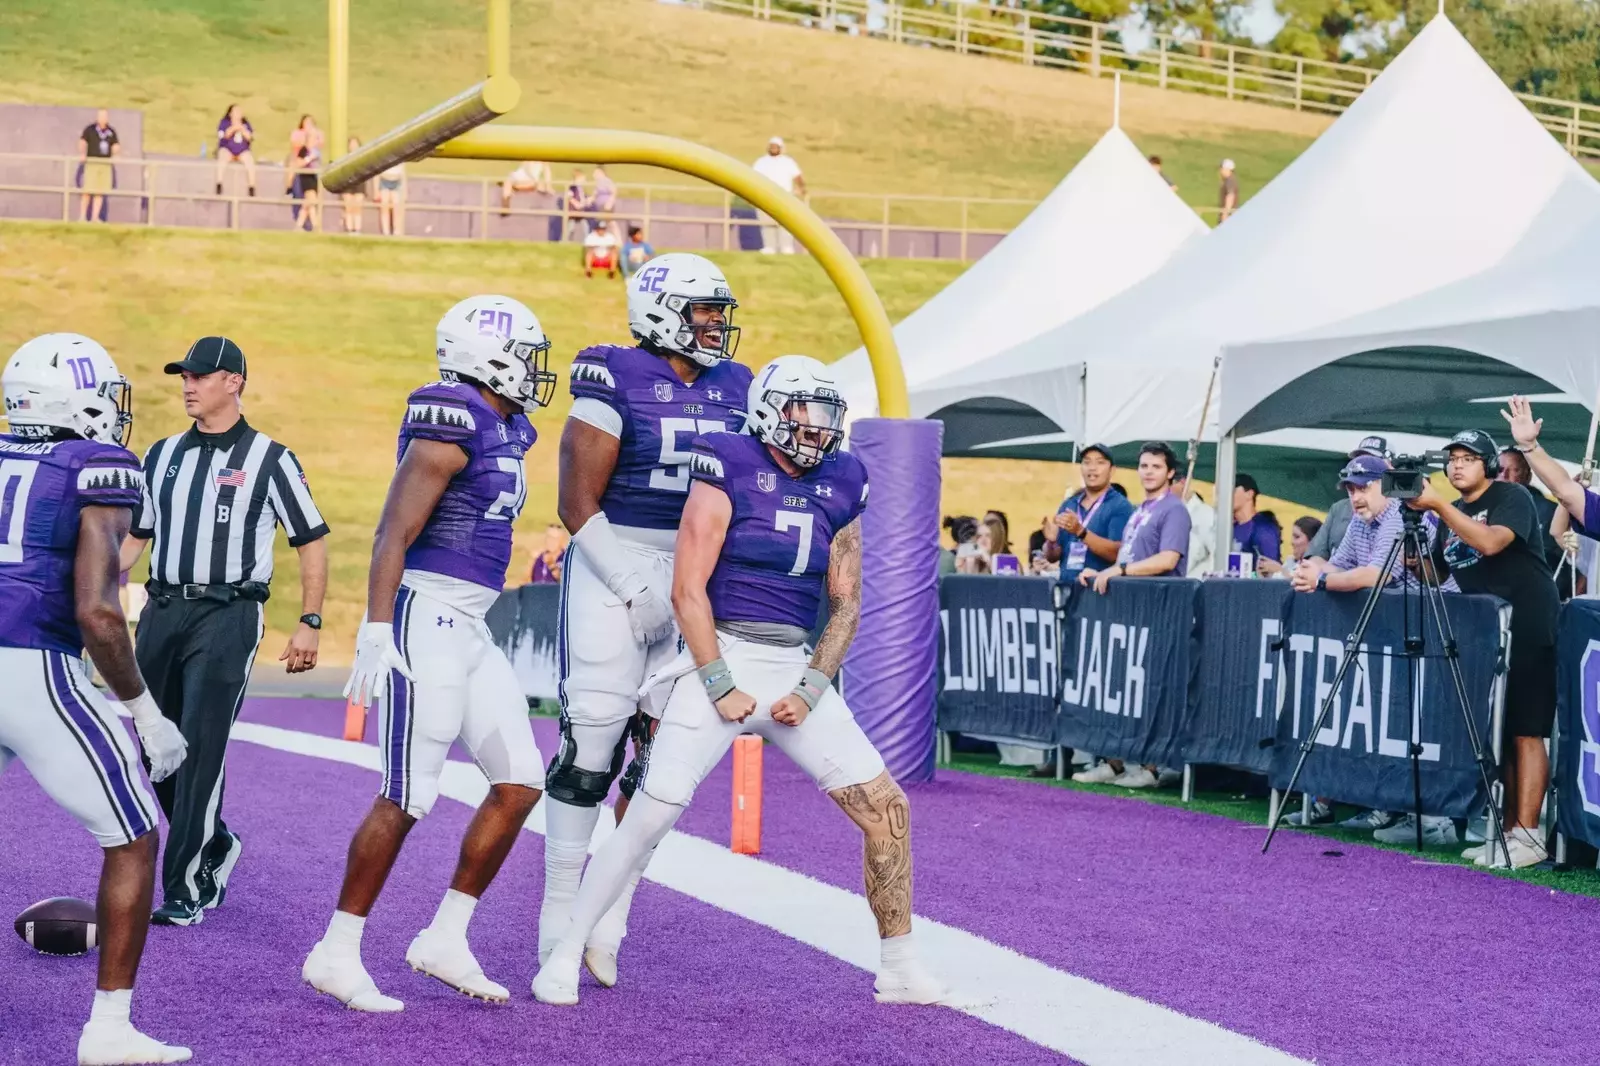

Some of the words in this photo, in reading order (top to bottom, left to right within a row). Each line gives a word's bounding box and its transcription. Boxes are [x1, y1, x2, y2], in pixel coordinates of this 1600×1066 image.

[639, 268, 669, 292] 52
[478, 309, 513, 339] 20
[66, 356, 97, 390] 10
[762, 364, 779, 388] 7
[649, 418, 727, 491] 5
[0, 459, 40, 563] 0
[216, 505, 231, 523] B
[774, 510, 814, 577] 7
